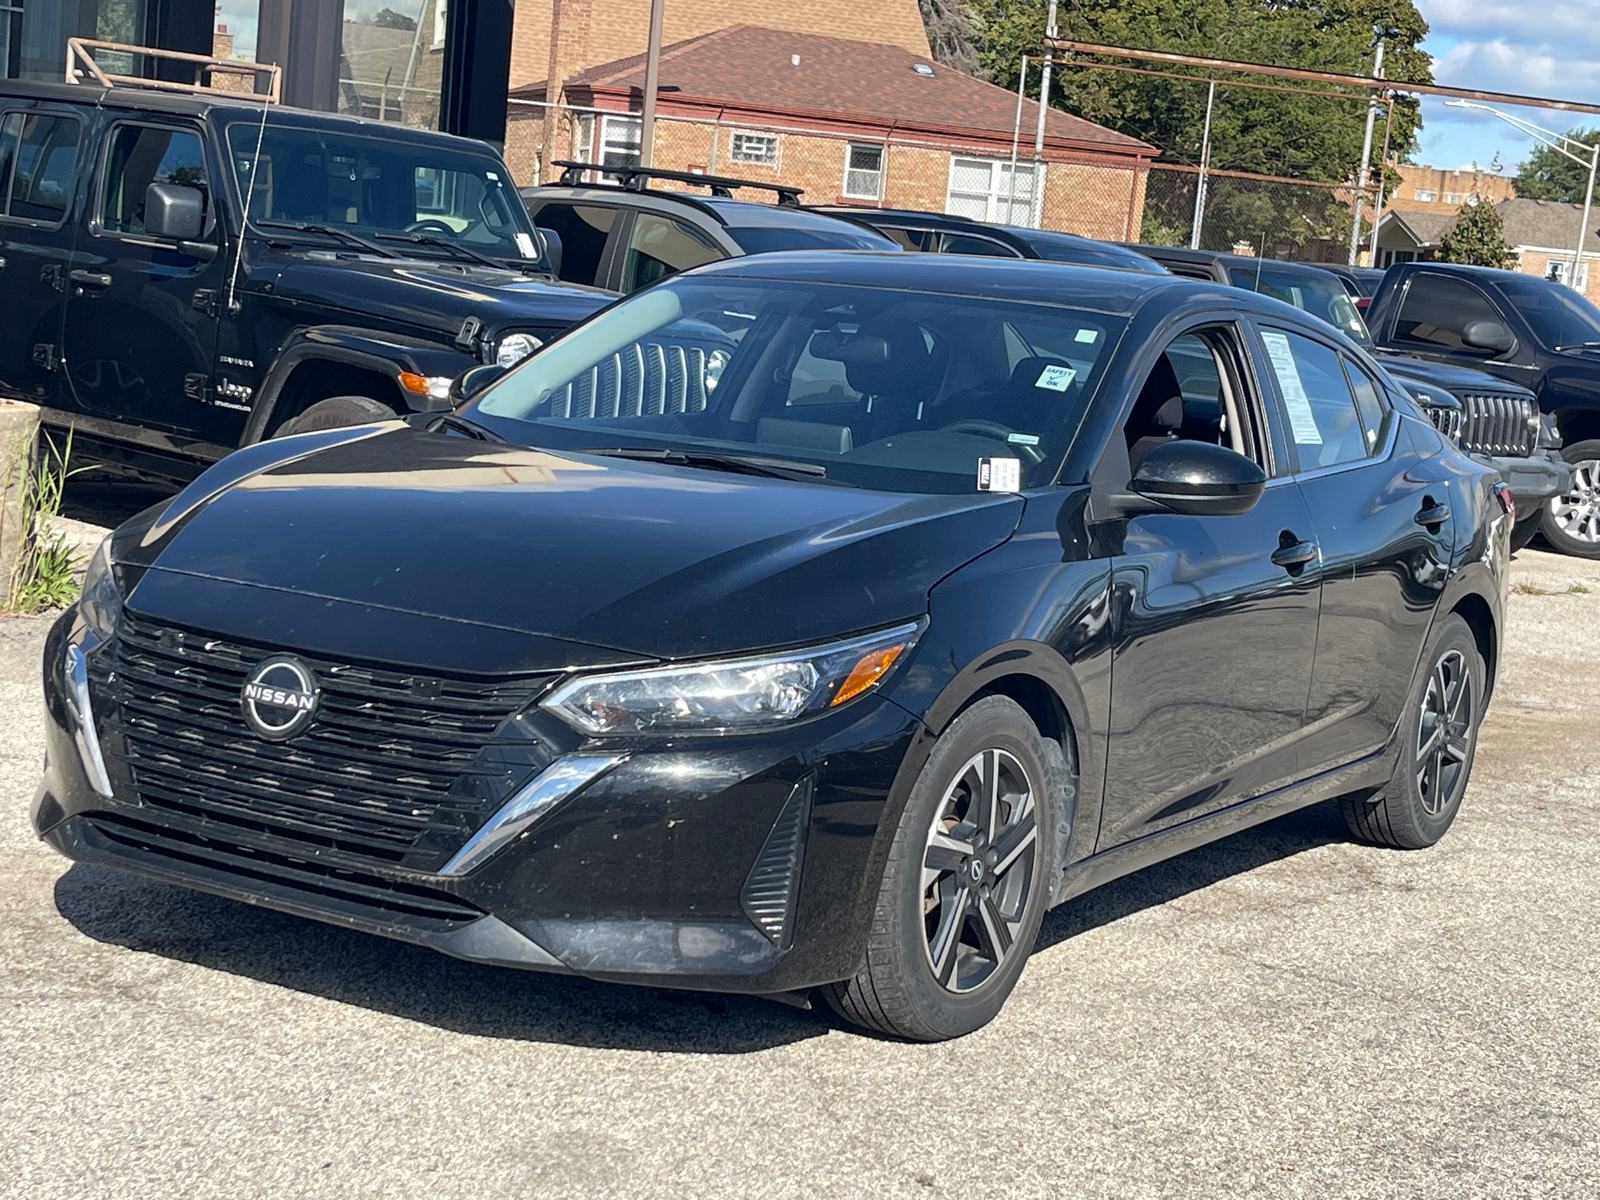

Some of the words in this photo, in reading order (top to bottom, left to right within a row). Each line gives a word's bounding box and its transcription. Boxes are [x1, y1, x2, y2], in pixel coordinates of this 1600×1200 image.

[1046, 368, 1073, 377] SAFETY
[216, 377, 253, 403] Jeep
[245, 684, 314, 709] NISSAN
